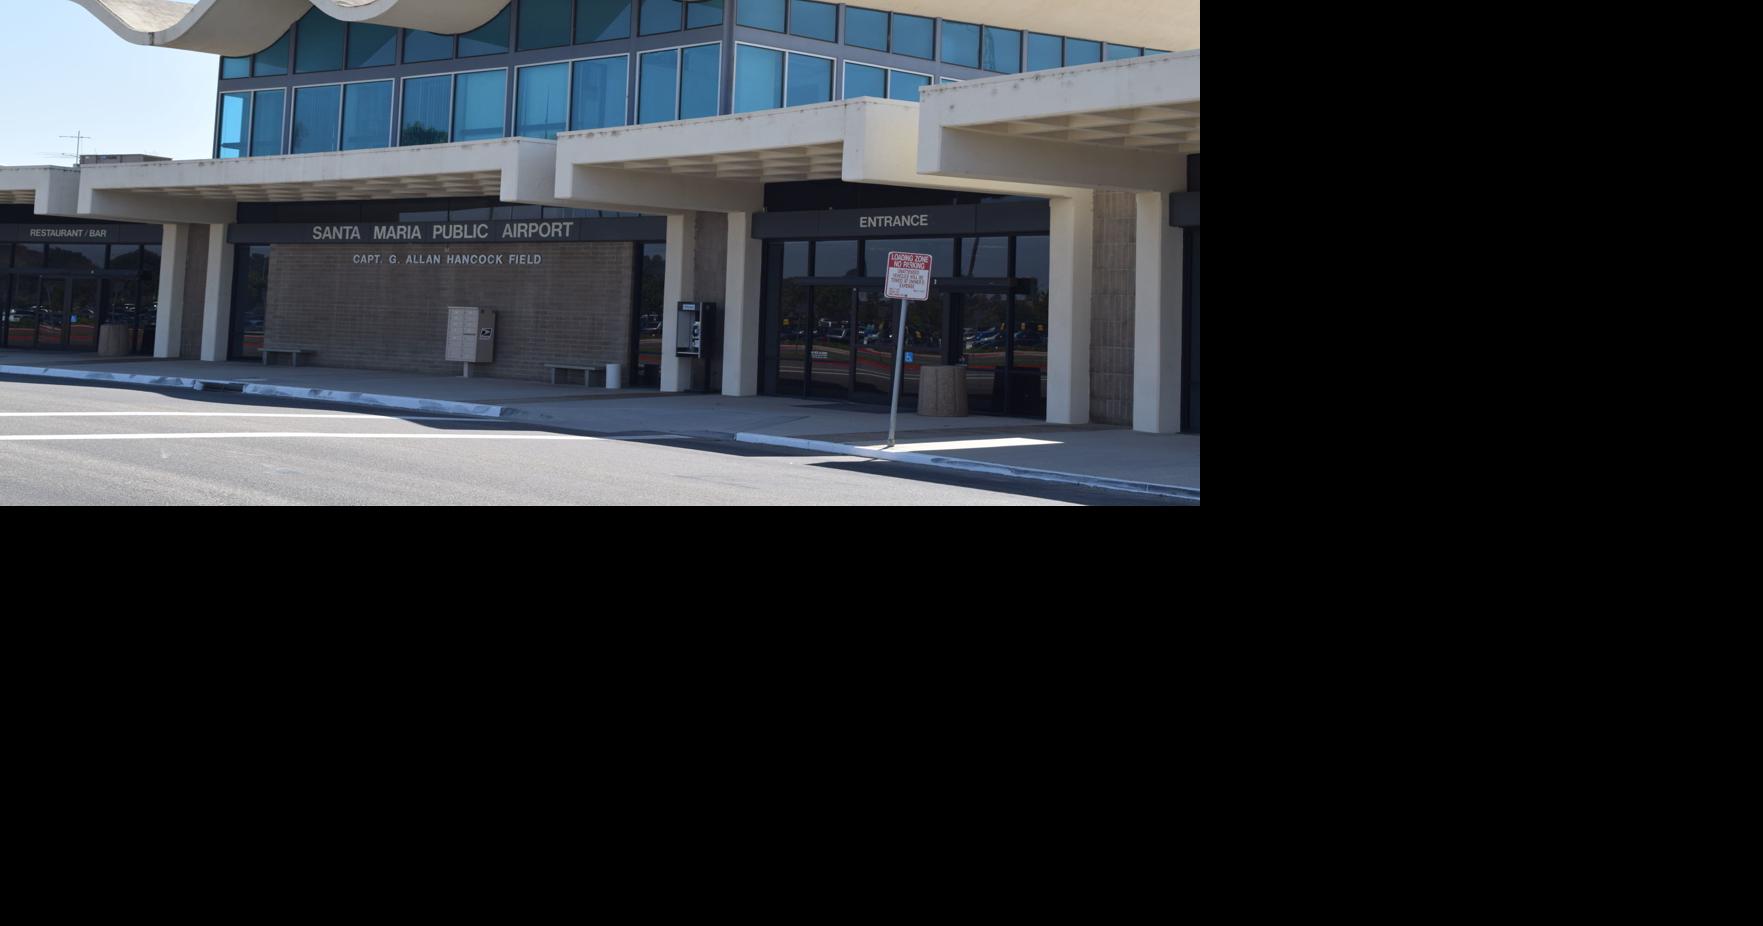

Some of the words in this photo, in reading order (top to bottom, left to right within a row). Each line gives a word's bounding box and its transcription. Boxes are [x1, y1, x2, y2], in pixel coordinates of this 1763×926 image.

[859, 214, 929, 228] ENTRANCE
[30, 228, 83, 237] RESTAURANT
[89, 229, 107, 237] BAR
[312, 225, 361, 240] SANTA
[373, 225, 422, 239] MARIA
[432, 223, 489, 239] PUBLIC
[502, 221, 574, 239] AIRPORT
[353, 254, 382, 264] CAPT.
[388, 254, 400, 264] G.
[405, 254, 441, 264] ALLAN
[446, 254, 503, 264] HANCOCK
[508, 254, 542, 264] FIELD
[894, 260, 902, 268] NO
